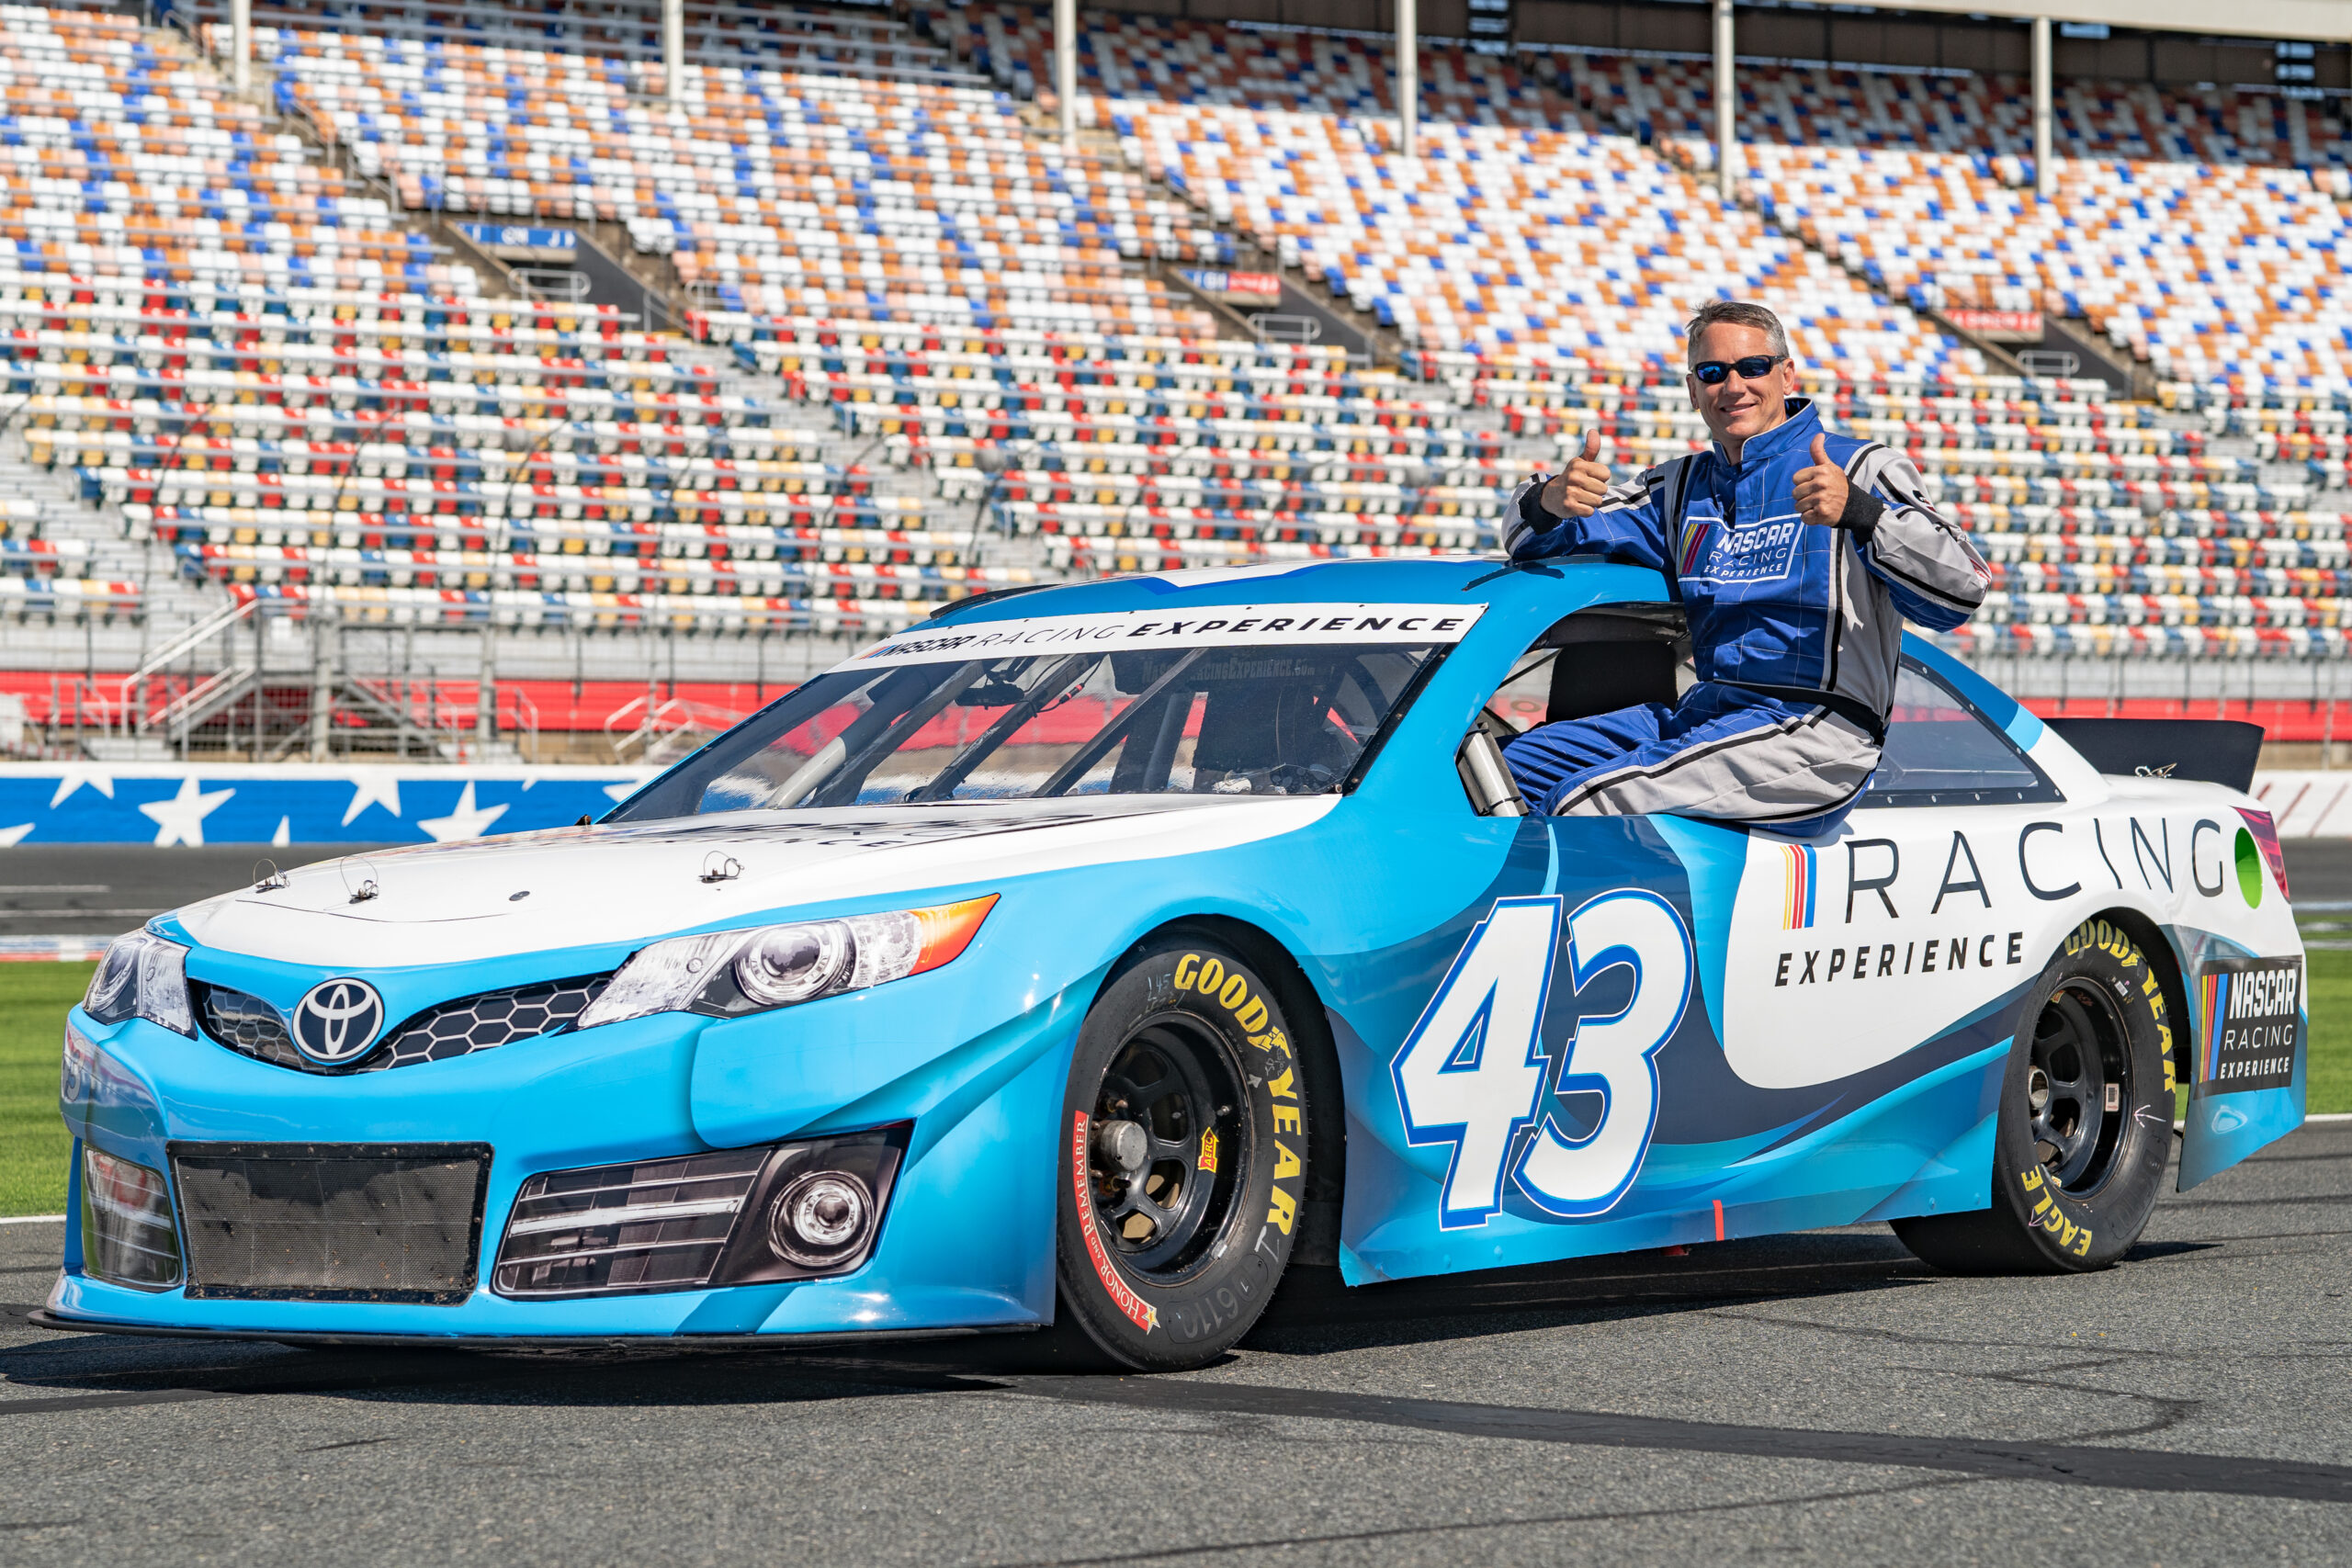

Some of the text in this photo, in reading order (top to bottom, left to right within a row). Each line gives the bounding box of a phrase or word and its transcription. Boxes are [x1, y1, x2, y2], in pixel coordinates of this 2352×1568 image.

[1709, 547, 1787, 568] RACING
[1716, 523, 1795, 555] NASCAR
[1703, 563, 1782, 578] EXPERIENCE
[876, 617, 1465, 657] NASCAR RACING EXPERIENCE
[1844, 817, 2223, 923] RACING
[1774, 931, 2023, 987] EXPERIENCE
[2229, 968, 2297, 1020] NASCAR
[2223, 1024, 2293, 1051] RACING
[1390, 887, 1693, 1232] 43
[2220, 1056, 2290, 1079] EXPERIENCE
[1204, 1136, 1214, 1167] AERO
[1076, 1122, 1140, 1320] HONOR AND REMEMBER
[2021, 1165, 2093, 1257] EAGLE
